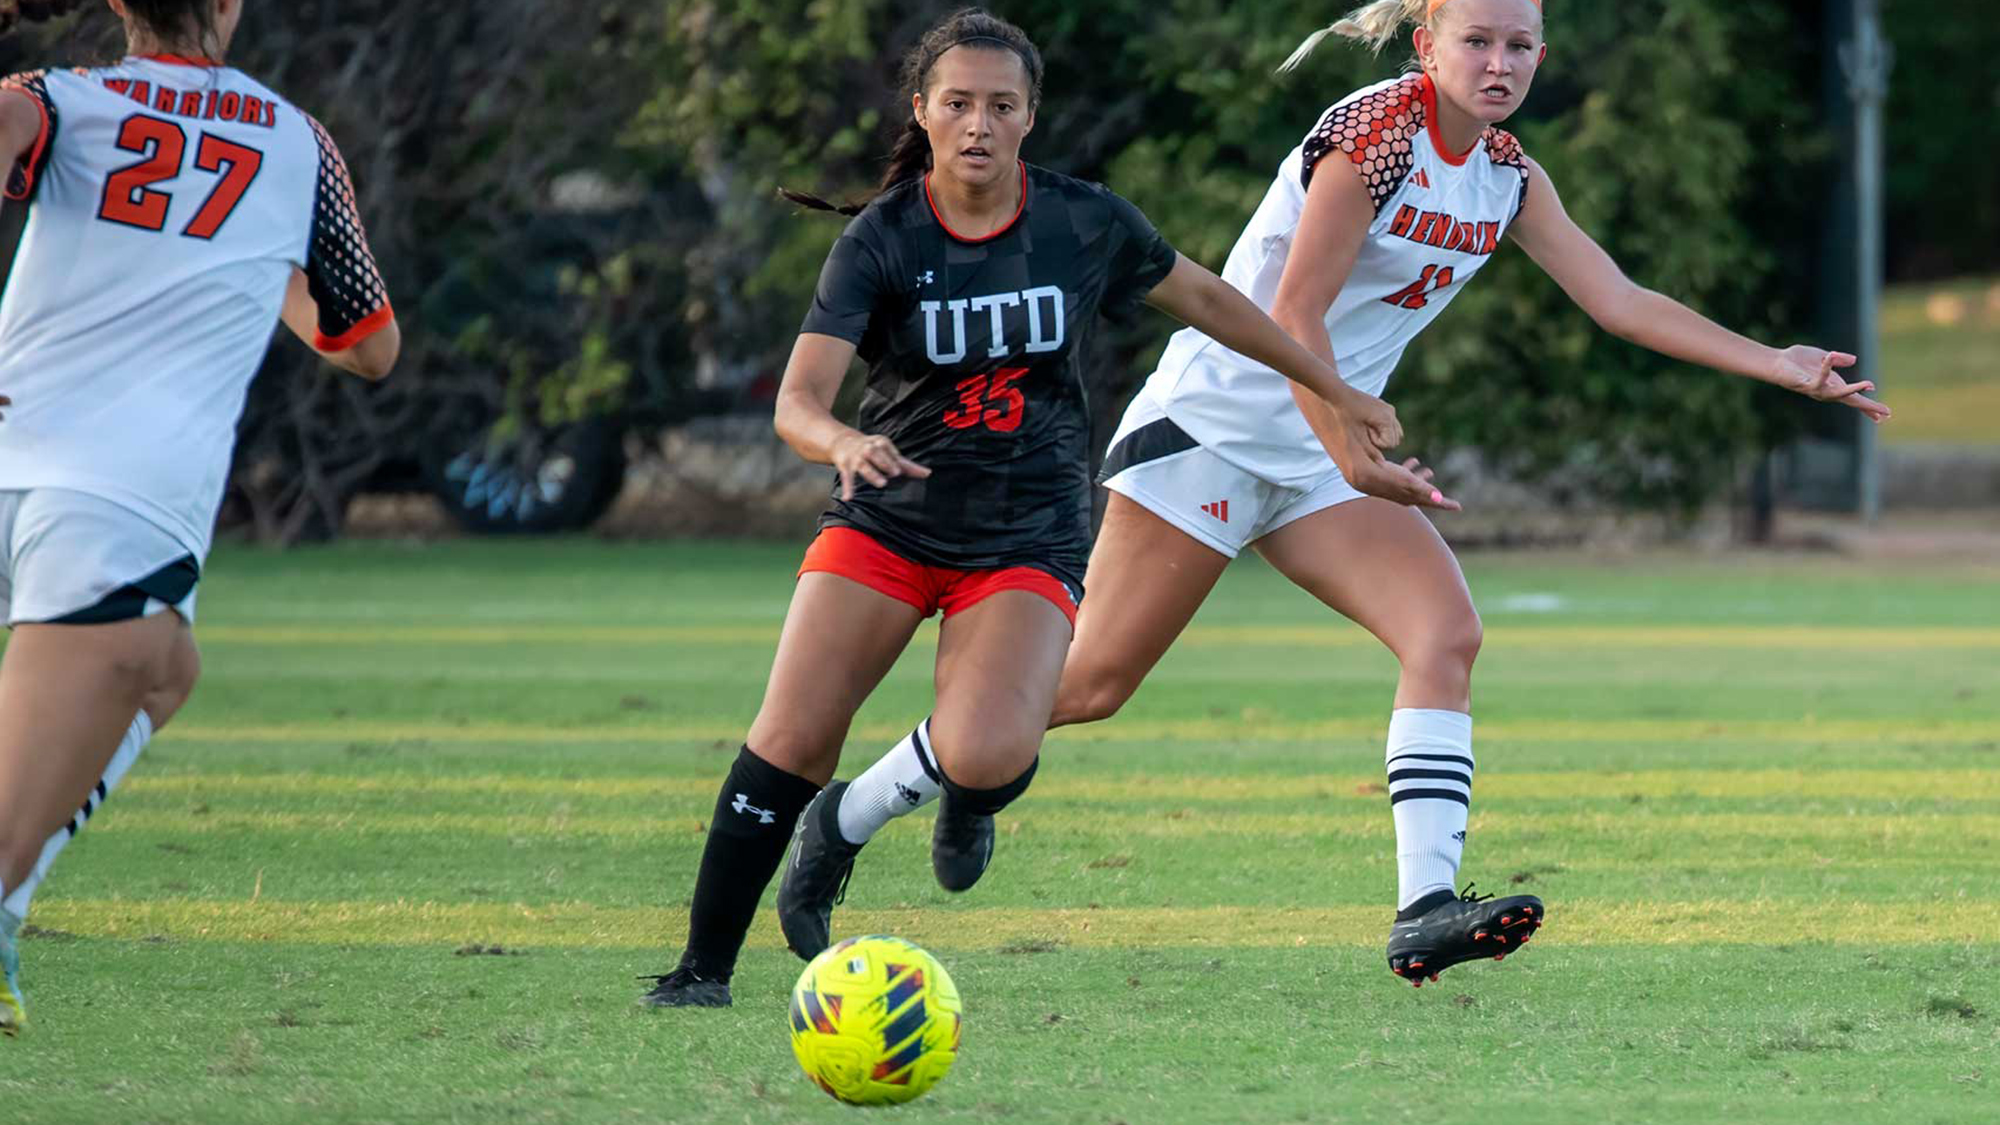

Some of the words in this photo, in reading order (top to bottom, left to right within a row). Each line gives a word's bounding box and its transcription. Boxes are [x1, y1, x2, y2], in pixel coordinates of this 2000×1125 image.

[97, 113, 263, 240] 27
[1387, 202, 1500, 256] HENDRIX
[920, 285, 1064, 365] UTD
[943, 367, 1030, 432] 35
